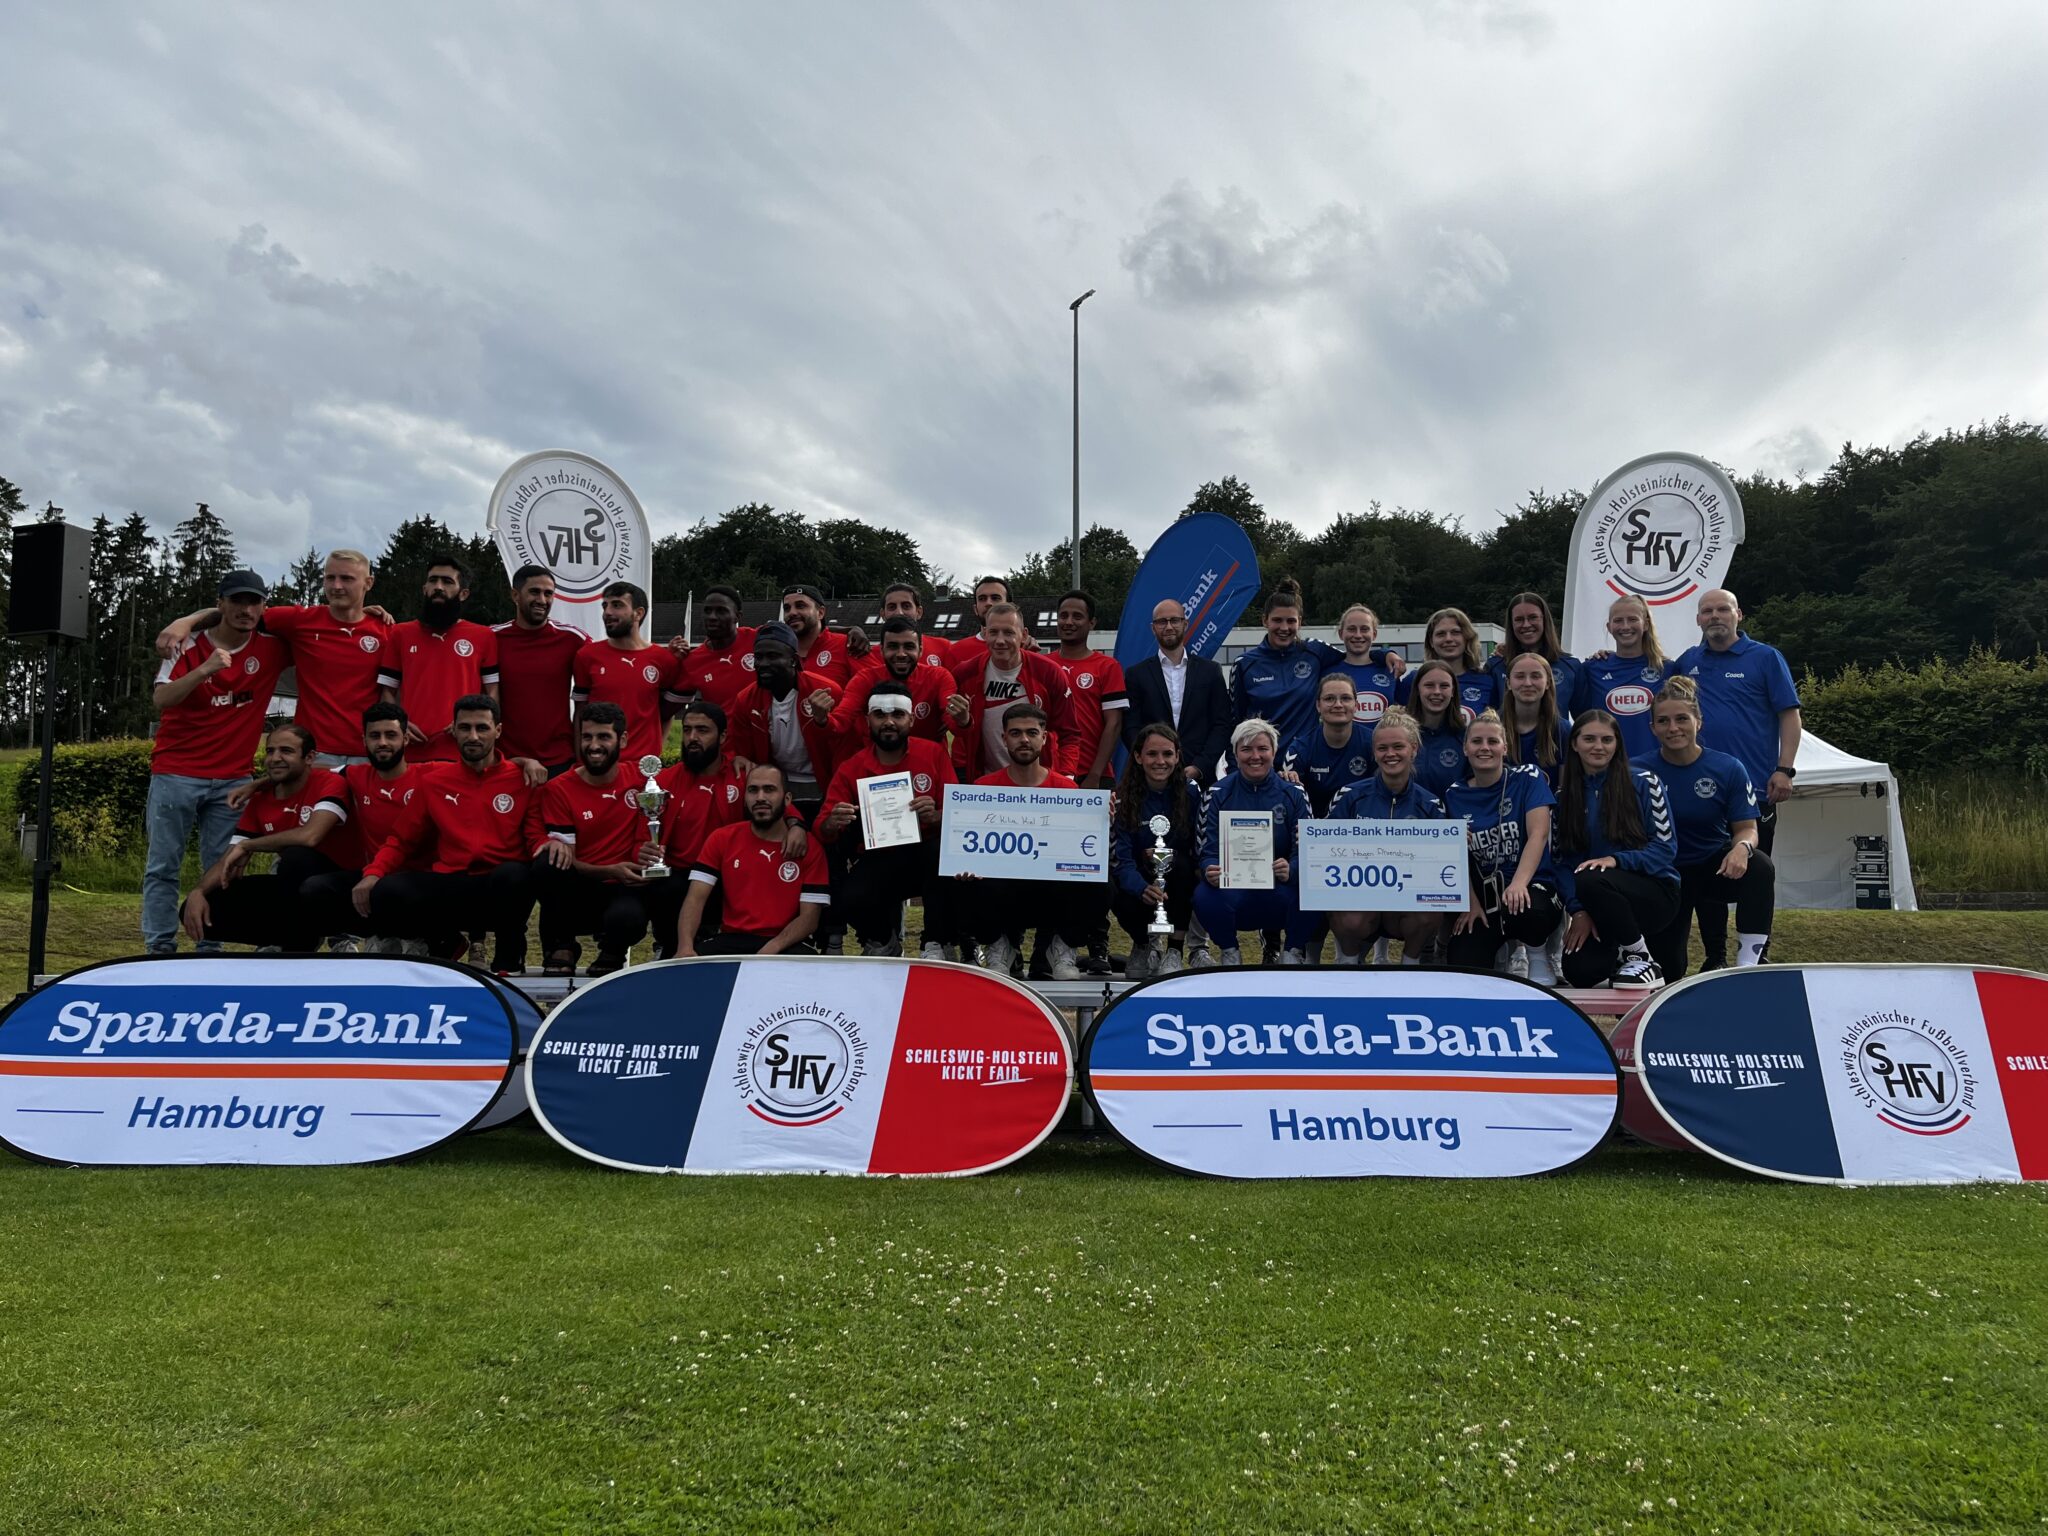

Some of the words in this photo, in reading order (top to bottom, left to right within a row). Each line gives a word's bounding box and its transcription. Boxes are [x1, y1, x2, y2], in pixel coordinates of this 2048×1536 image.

[1591, 473, 1693, 574] Schleswig-Holsteinischer
[1694, 484, 1725, 579] Fußballverband
[1252, 675, 1275, 683] hummel
[1724, 671, 1745, 679] Coach
[986, 680, 1021, 699] NIKE
[1614, 694, 1645, 705] HELA
[951, 790, 1026, 805] Sparda-Bank
[1029, 793, 1083, 807] Hamburg
[1086, 796, 1103, 806] eG
[1306, 826, 1382, 838] Sparda-Bank
[1385, 826, 1440, 838] Hamburg
[1443, 827, 1459, 836] eG
[962, 830, 1048, 860] 3.000,-
[1080, 834, 1097, 857] €
[1330, 847, 1347, 857] SSC
[1324, 865, 1412, 892] 3.000,-
[1439, 865, 1457, 888] €
[48, 1001, 468, 1054] Sparda-Bank
[1146, 1012, 1559, 1067] Sparda-Bank
[543, 1040, 700, 1060] SCHLESWIG-HOLSTEIN
[733, 1001, 832, 1099] Schleswig-Holsteinischer
[834, 1012, 869, 1102] Fußballverband
[905, 1048, 1059, 1065] SCHLESWIG-HOLSTEIN
[1840, 1009, 1916, 1109] Schleswig-Holsteinischer
[1921, 1019, 1979, 1110] Fußballverband
[578, 1057, 622, 1075] KICKT
[626, 1059, 659, 1075] FAIR
[765, 1033, 837, 1095] SHFV
[1648, 1052, 1804, 1069] SCHLESWIG-HOLSTEIN
[941, 1065, 984, 1080] KICKT
[988, 1065, 1020, 1081] FAIR
[1690, 1068, 1733, 1085] KICKT
[1738, 1070, 1771, 1085] FAIR
[1865, 1042, 1945, 1103] SHFV
[127, 1096, 325, 1137] Hamburg
[1268, 1107, 1461, 1150] Hamburg
